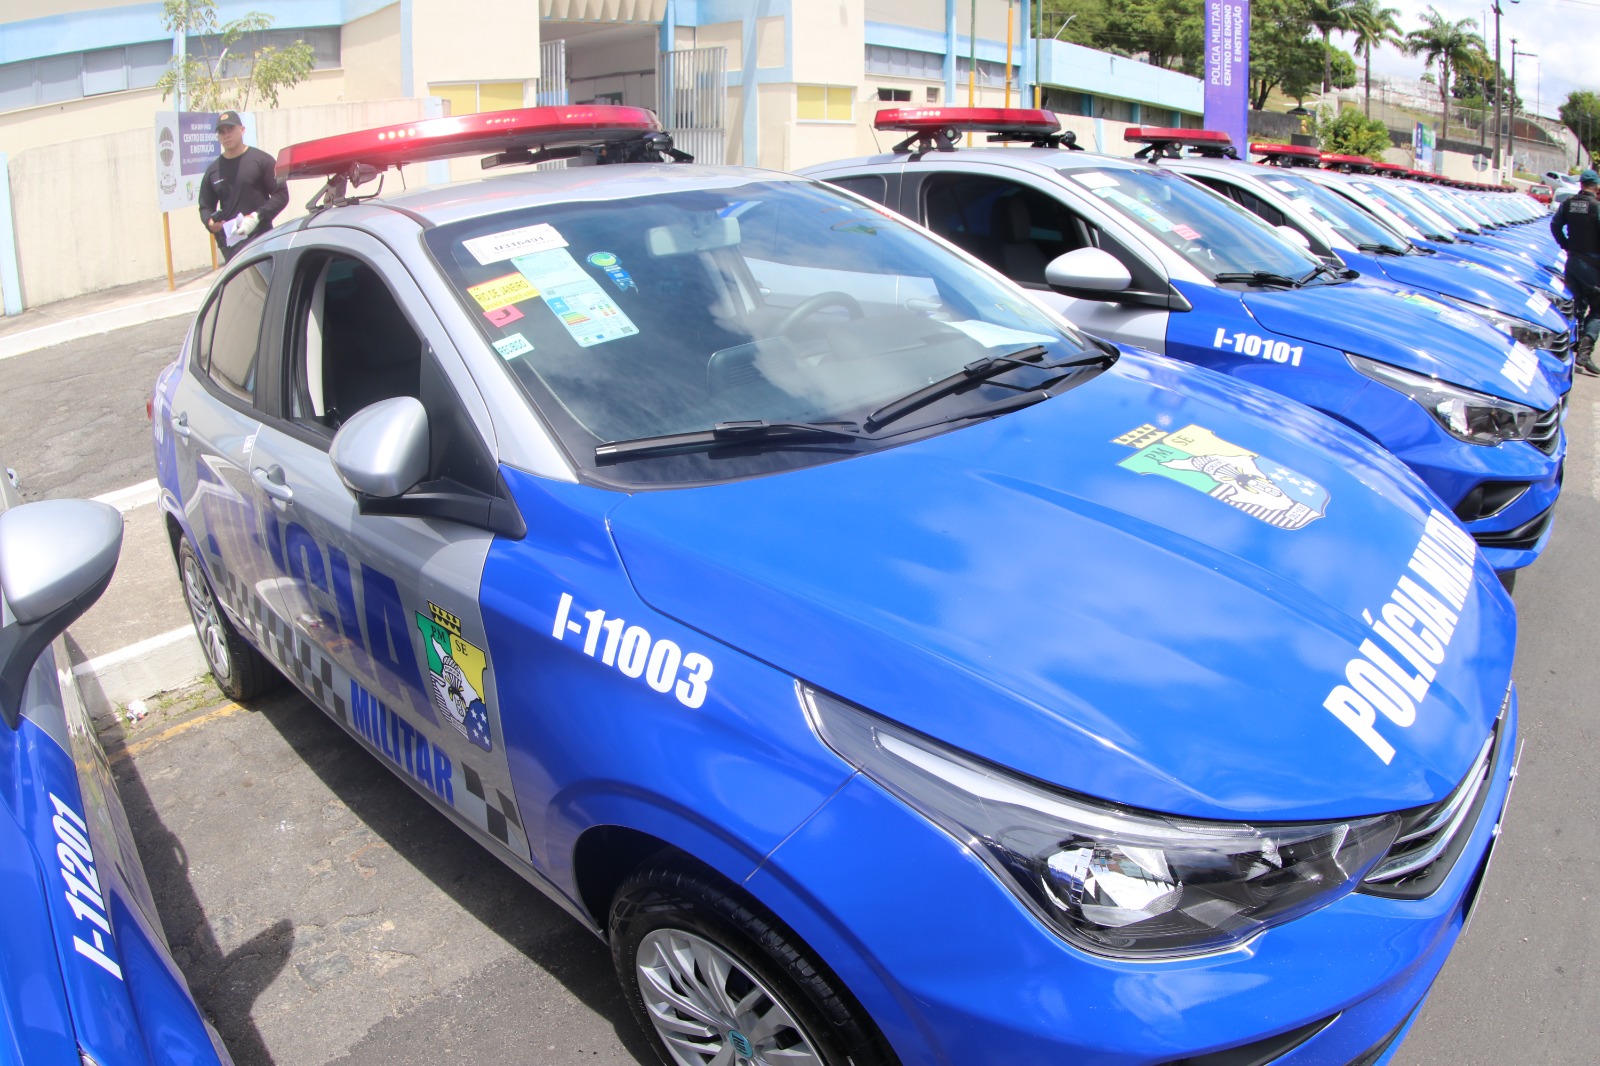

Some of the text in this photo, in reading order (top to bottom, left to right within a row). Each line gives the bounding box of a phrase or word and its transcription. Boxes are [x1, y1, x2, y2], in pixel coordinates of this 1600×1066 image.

[1209, 2, 1221, 85] POLÍCIA MILITAR
[1224, 4, 1232, 87] CENTRO DE ENSINO
[1233, 5, 1244, 55] INSTRUÇÃO
[1213, 327, 1304, 367] I-10101
[1144, 445, 1174, 462] PM
[1171, 434, 1195, 447] SE
[430, 624, 447, 644] PM
[454, 639, 469, 657] SE
[552, 592, 714, 709] I-11003
[1322, 573, 1459, 766] POLÍCIA
[350, 678, 455, 808] MILITAR
[49, 791, 124, 982] I-11201
